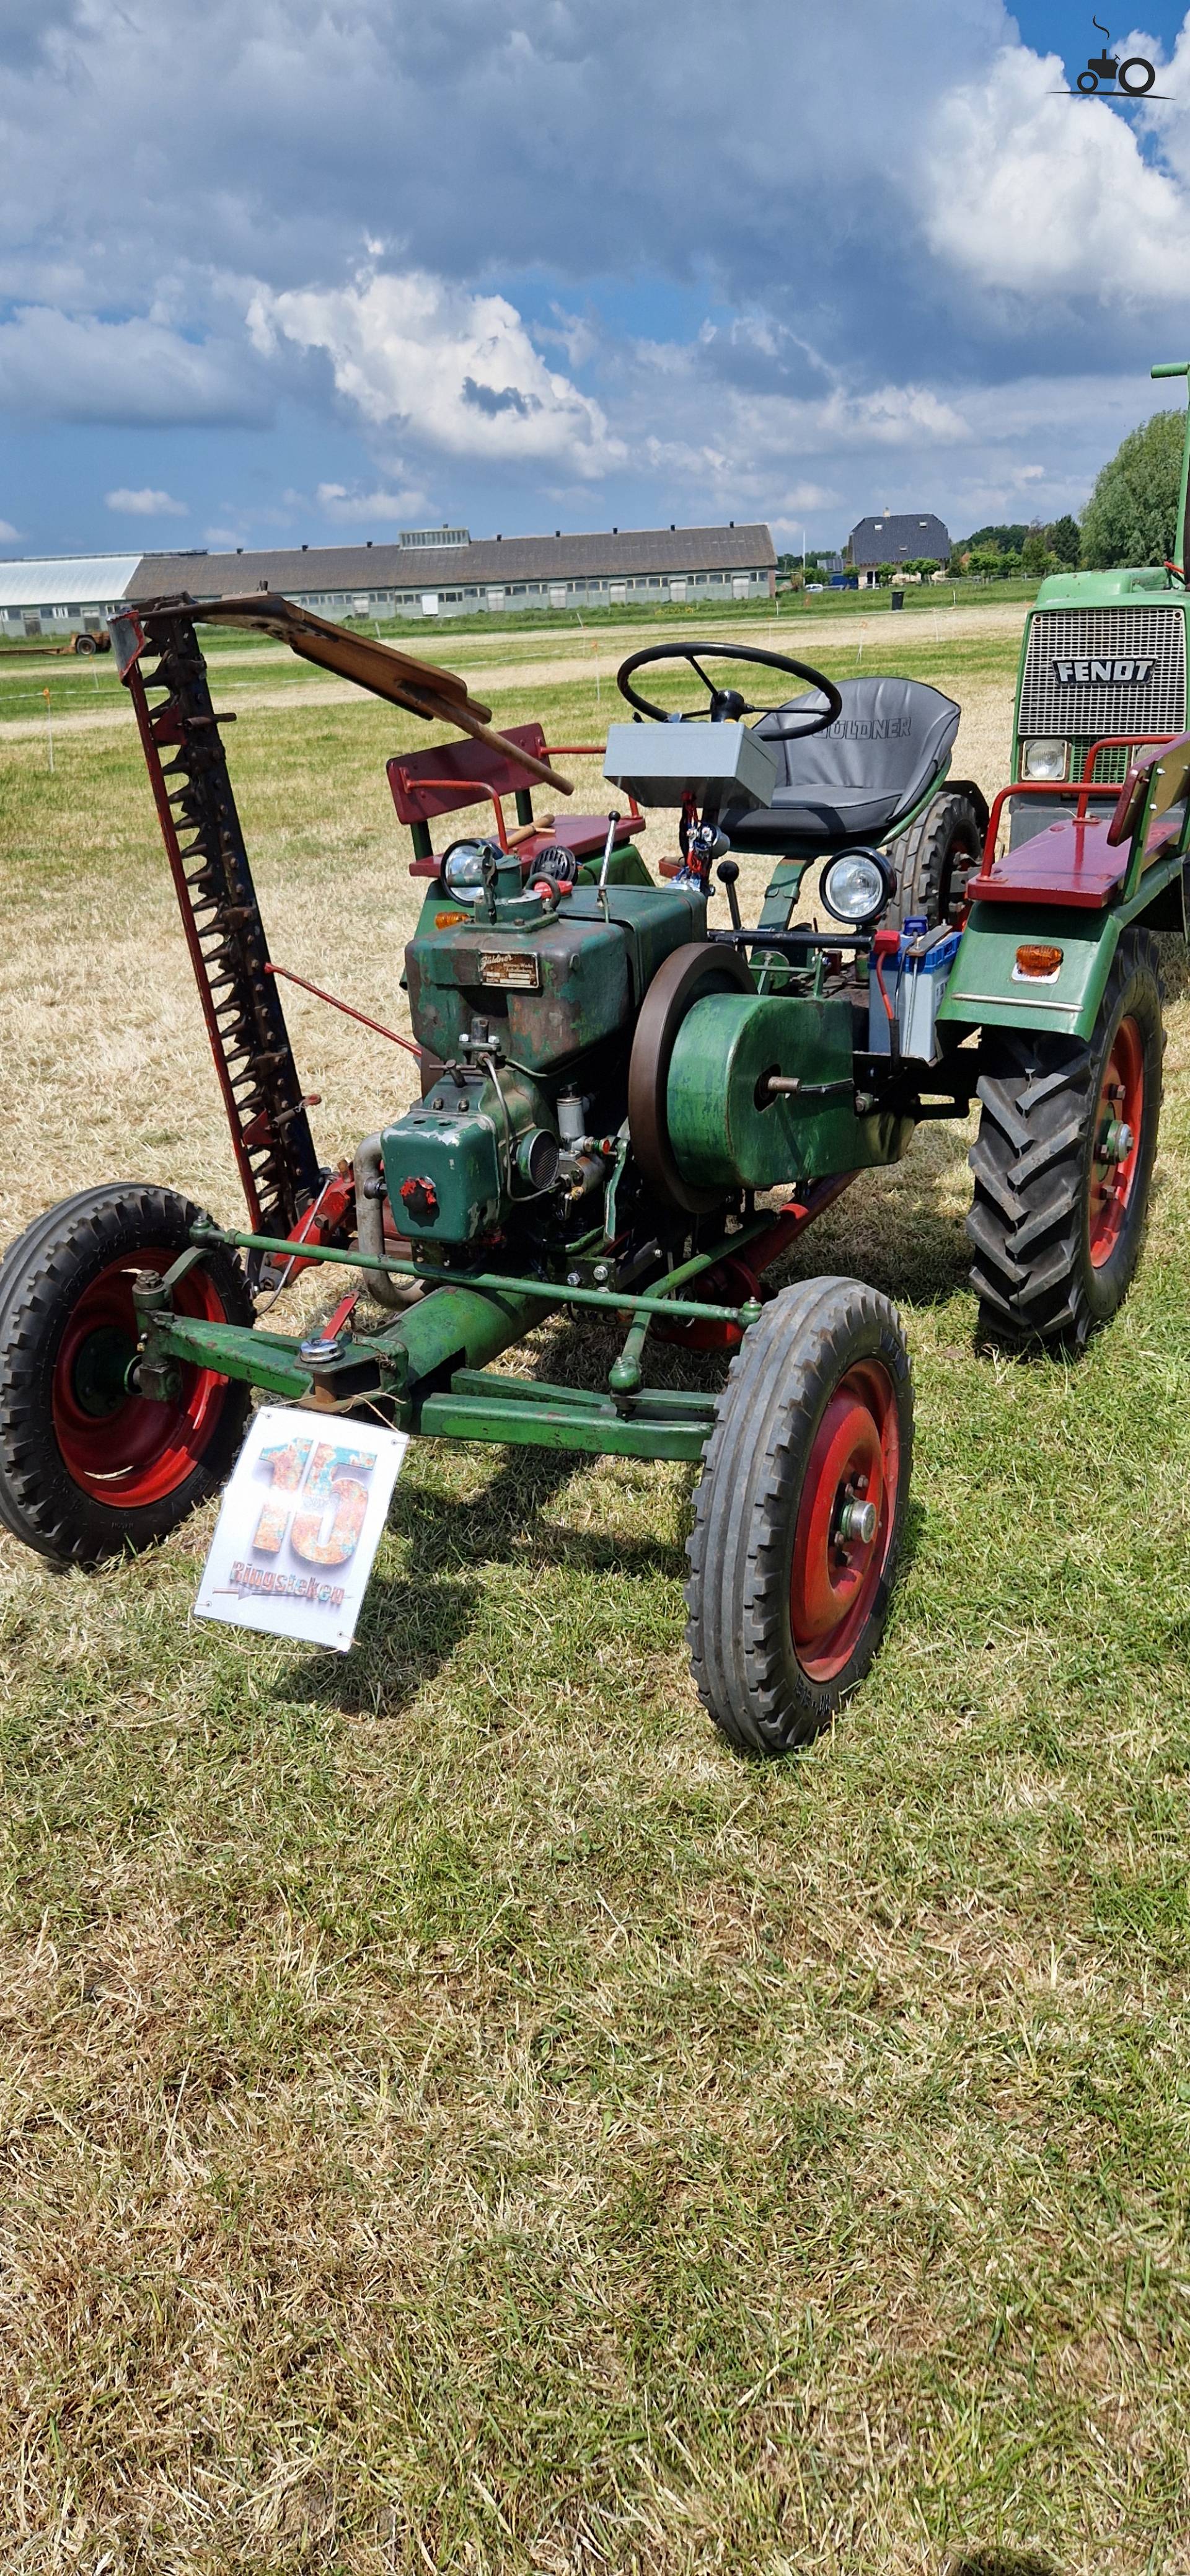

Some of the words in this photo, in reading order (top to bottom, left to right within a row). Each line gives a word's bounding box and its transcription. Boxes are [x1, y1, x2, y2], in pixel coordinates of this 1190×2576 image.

[1056, 660, 1153, 682] FENDT
[252, 1437, 377, 1564] 15
[229, 1561, 345, 1605] Ringsteken
